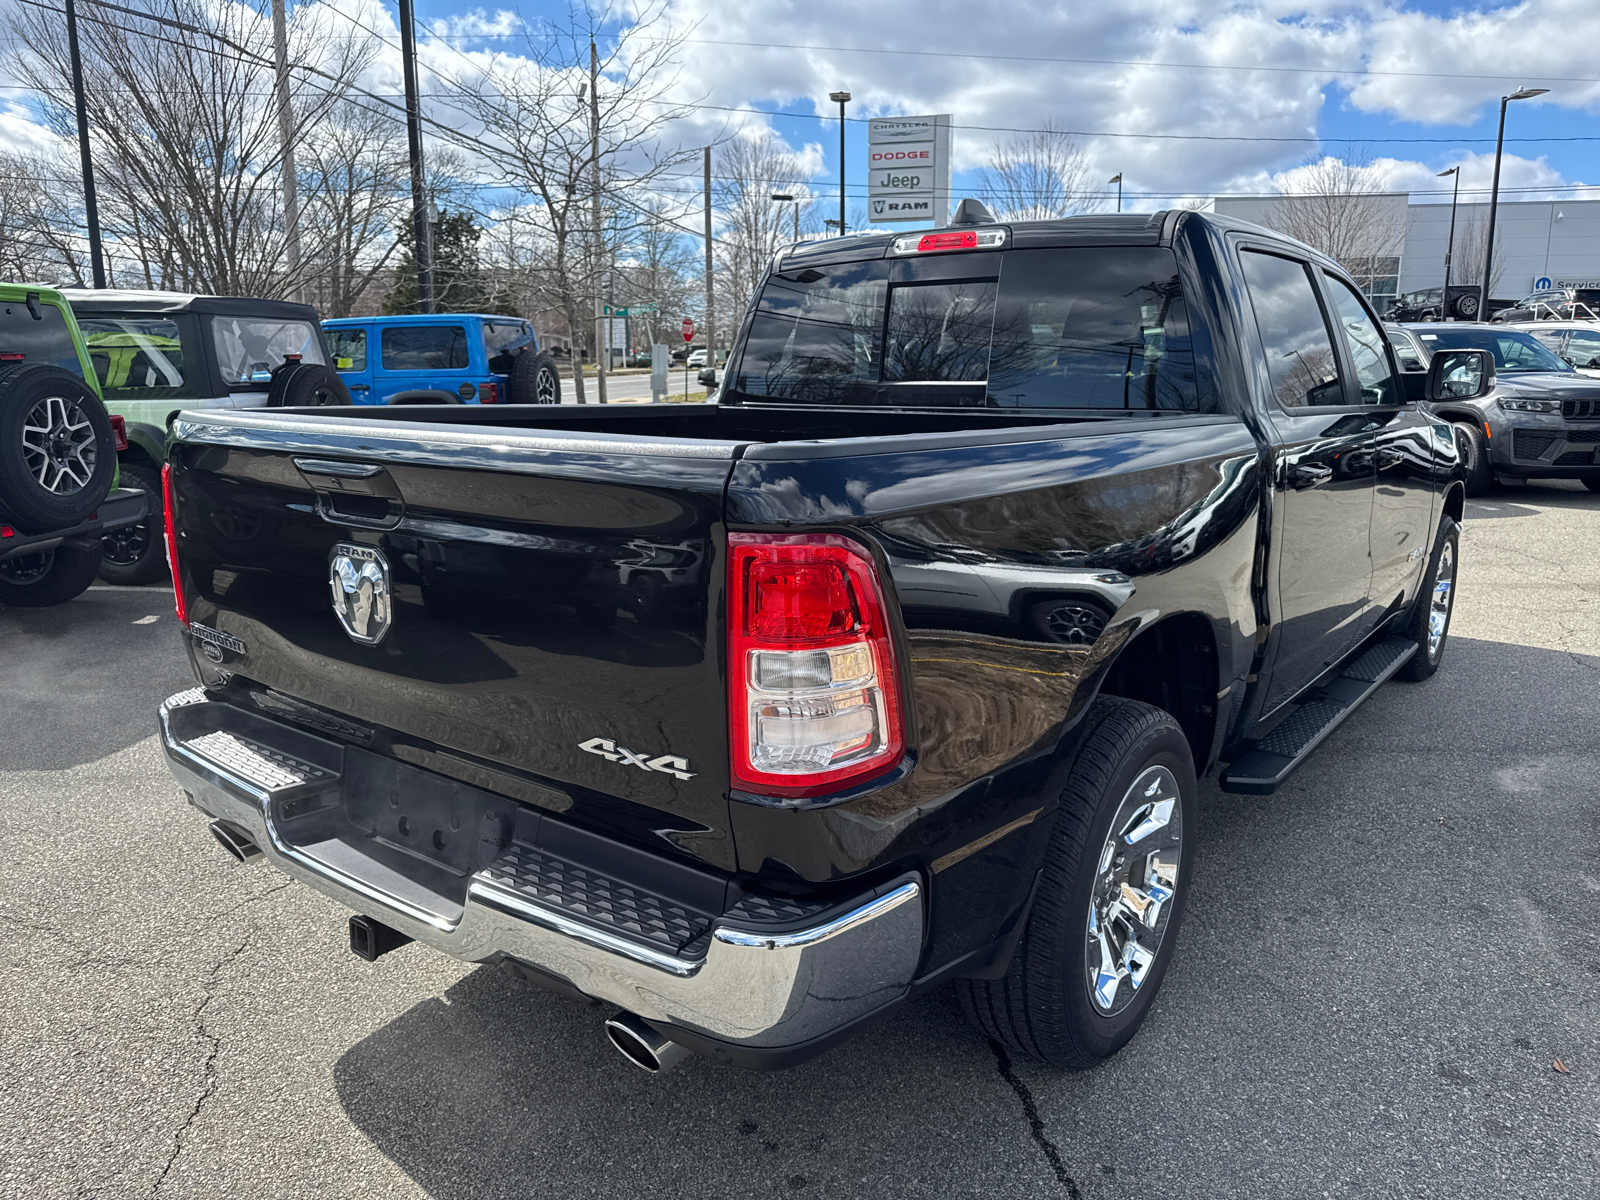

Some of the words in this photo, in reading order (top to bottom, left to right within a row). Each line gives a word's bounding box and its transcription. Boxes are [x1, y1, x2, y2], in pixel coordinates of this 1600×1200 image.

[872, 151, 930, 161] DODGE
[881, 173, 920, 189] Jeep
[888, 202, 929, 211] RAM
[338, 547, 375, 560] RAM
